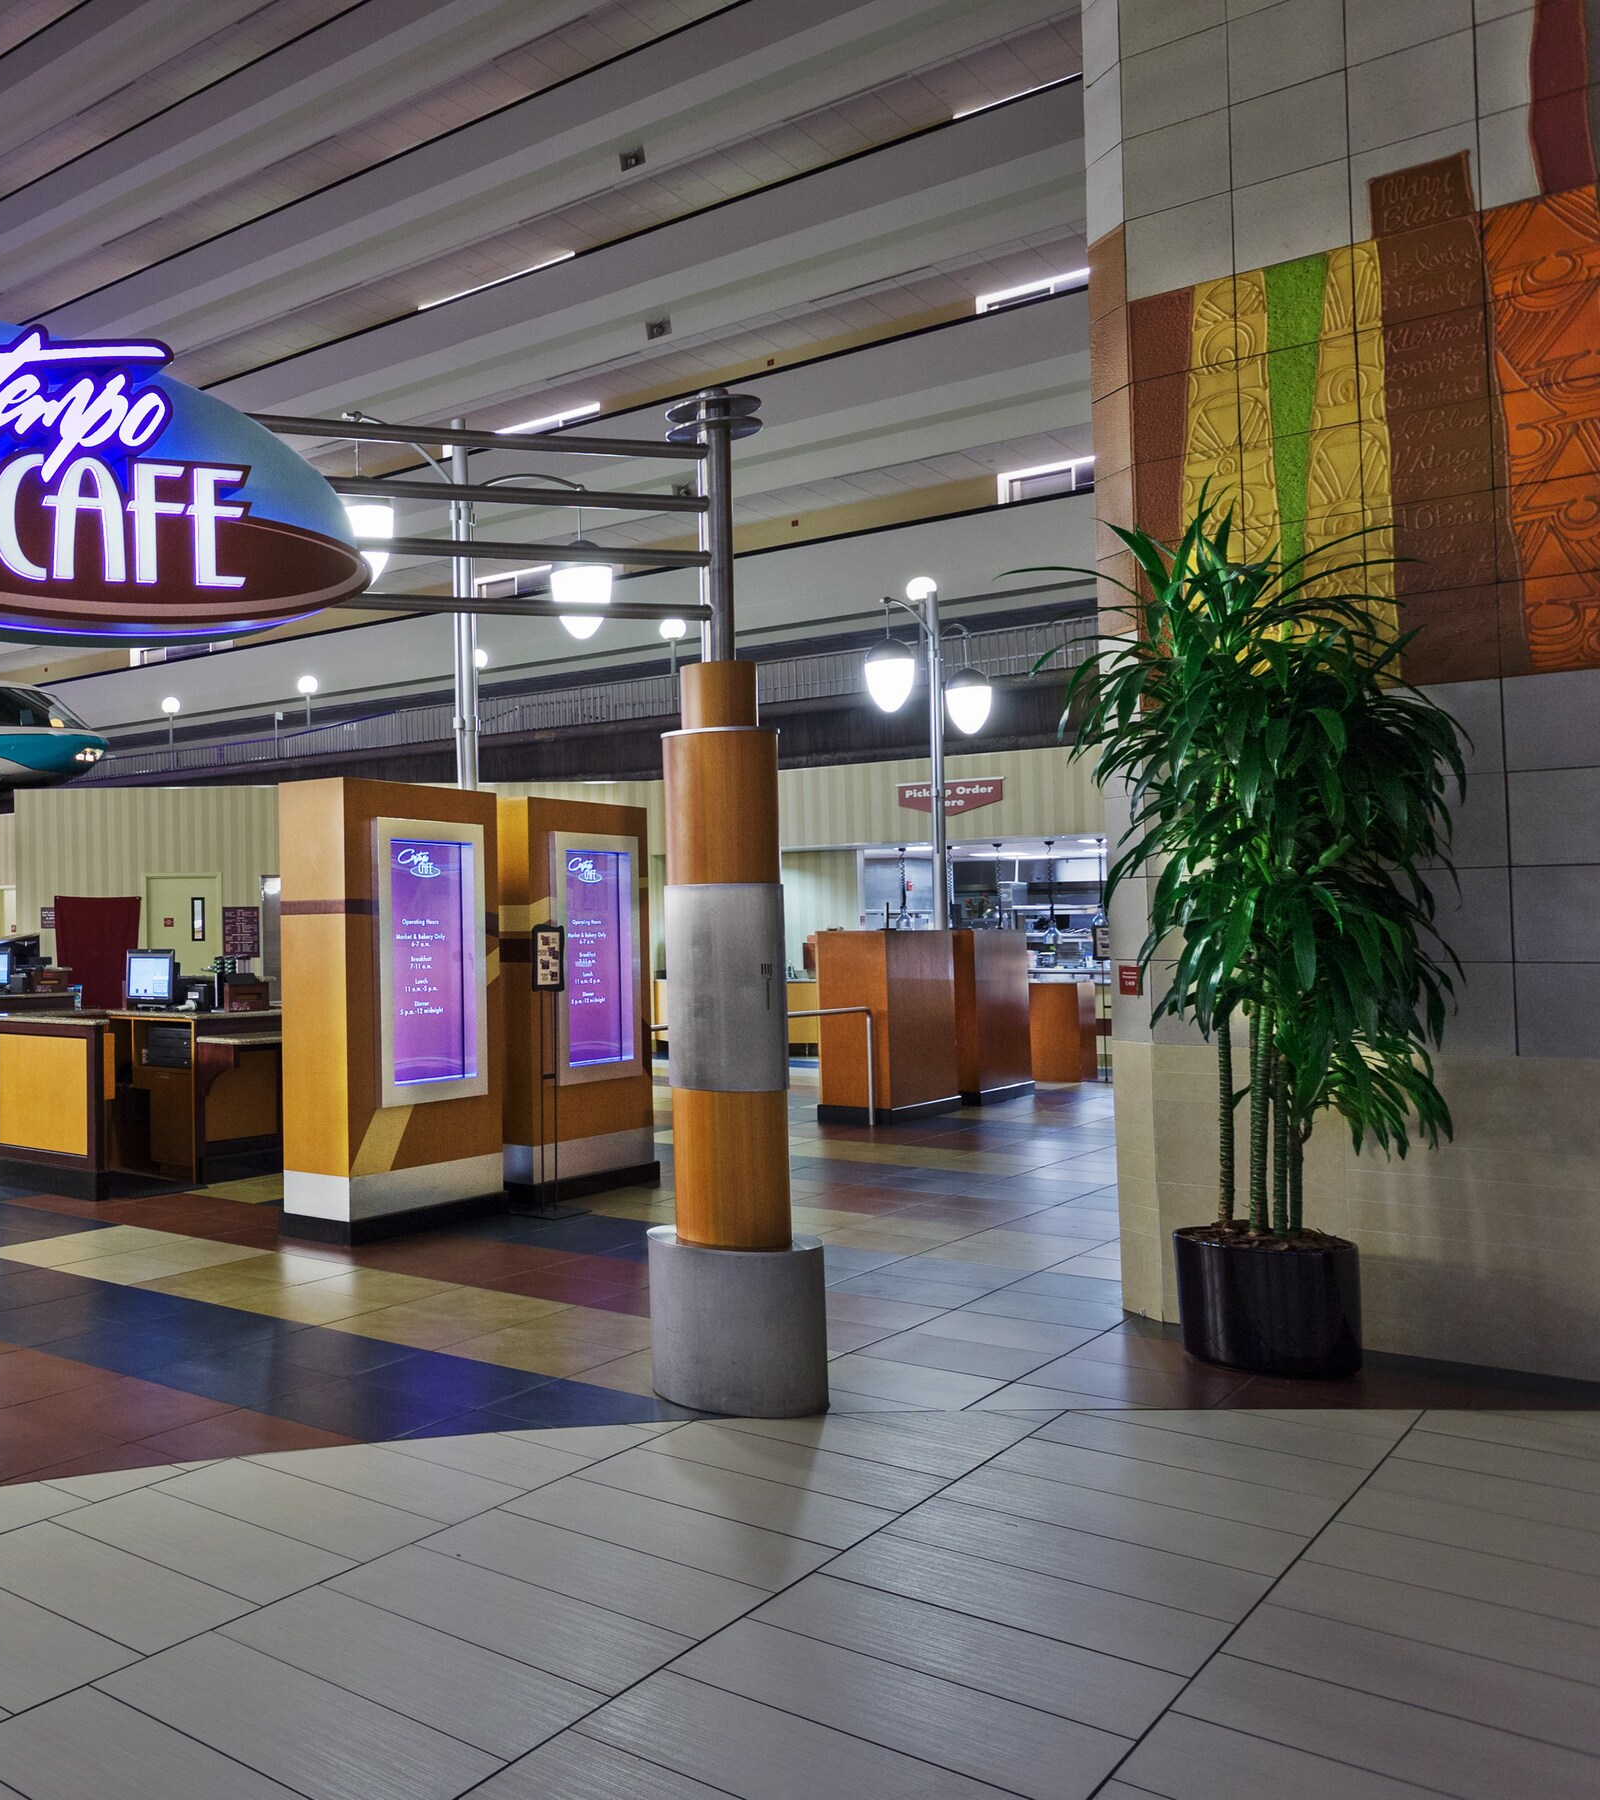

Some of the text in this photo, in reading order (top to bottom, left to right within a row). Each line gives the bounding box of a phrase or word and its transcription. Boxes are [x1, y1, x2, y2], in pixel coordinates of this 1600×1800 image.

[905, 788, 930, 798] Pick
[956, 784, 994, 795] Order
[418, 933, 433, 941] Bakery
[434, 933, 446, 941] Only
[415, 977, 428, 985] Lunch
